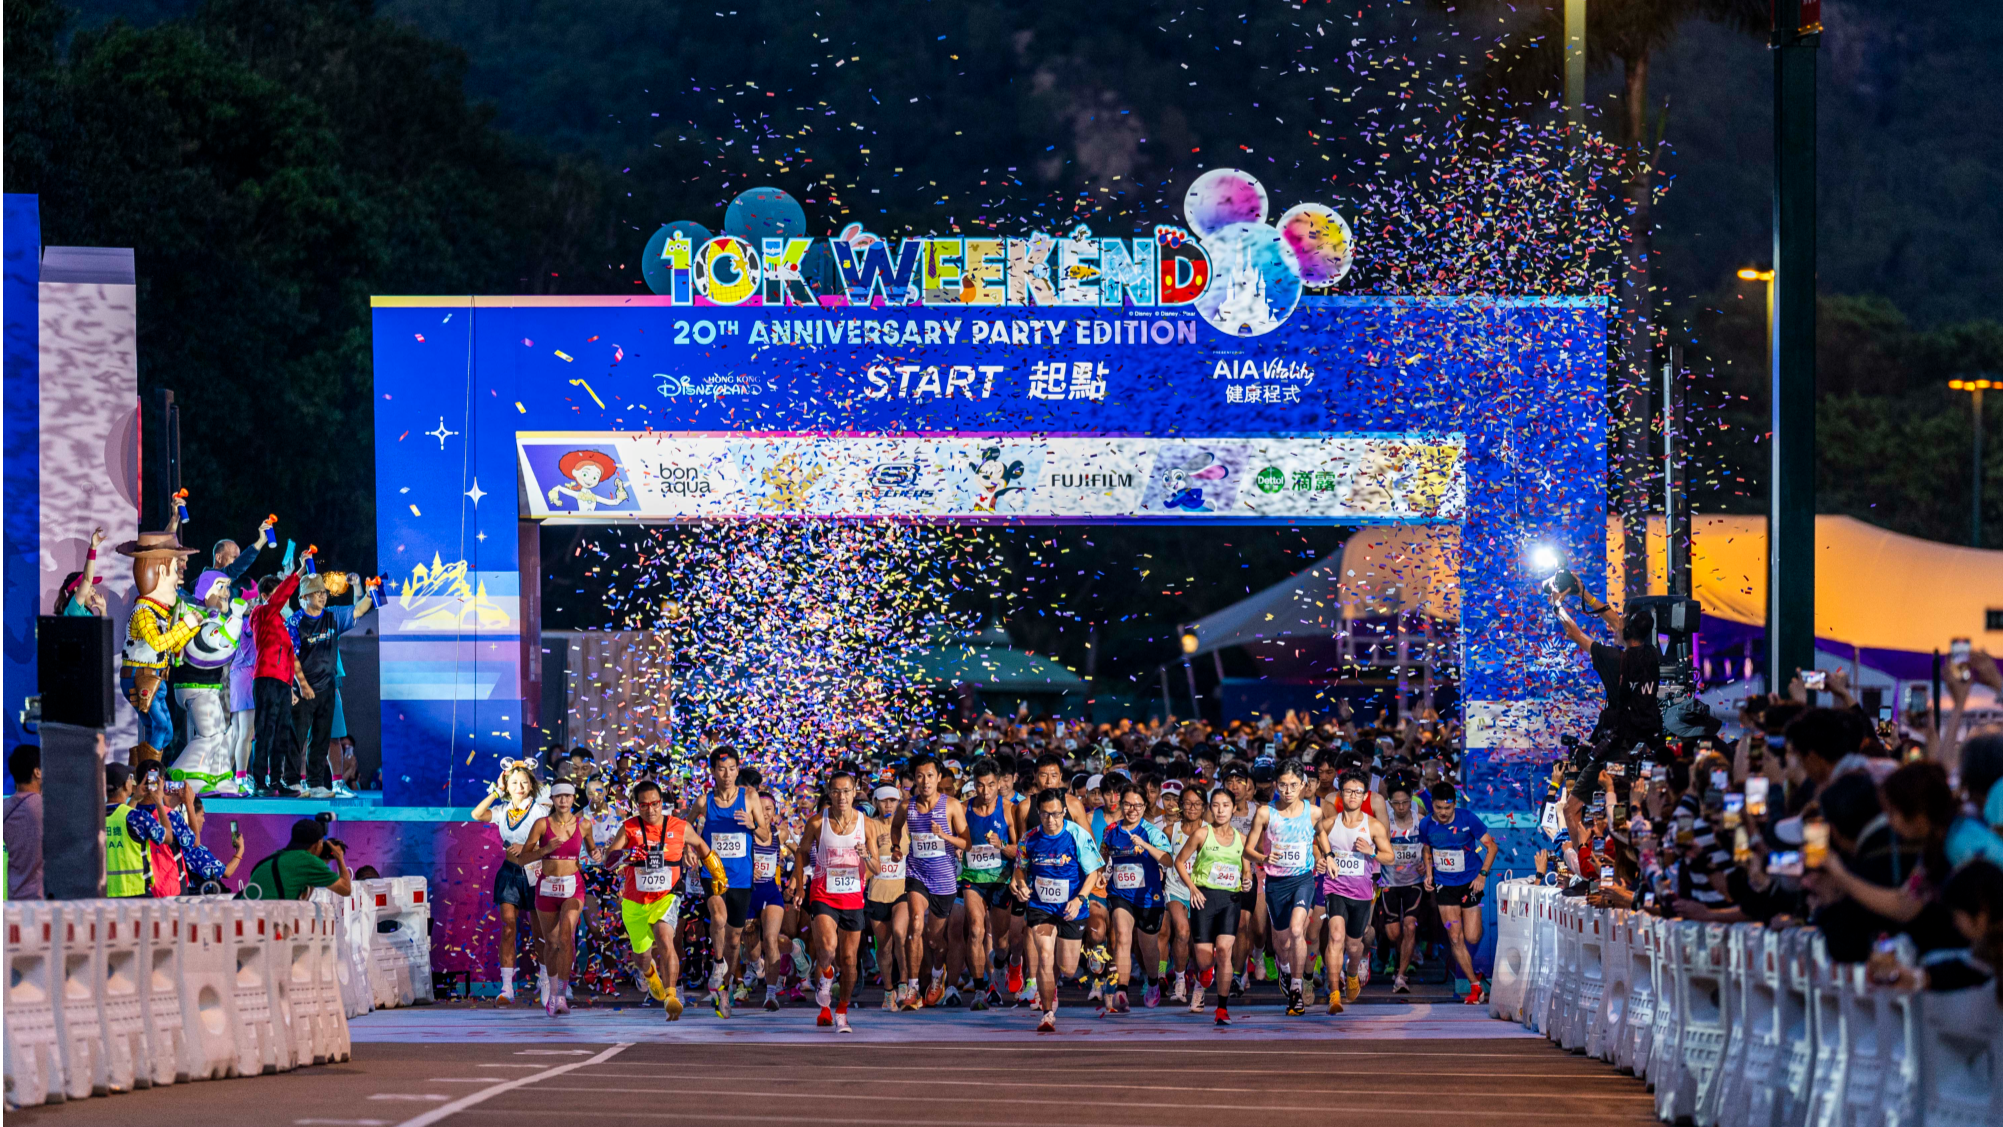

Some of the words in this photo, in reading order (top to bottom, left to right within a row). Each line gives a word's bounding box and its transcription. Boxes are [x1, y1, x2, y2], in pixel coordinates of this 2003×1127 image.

[660, 235, 822, 306] 10K
[828, 236, 1213, 307] WEEKEND
[673, 320, 739, 345] 20TH
[748, 320, 962, 345] ANNIVERSARY
[972, 320, 1066, 345] PARTY
[1076, 320, 1197, 345] EDITION
[1212, 359, 1260, 379] AIA
[1263, 356, 1316, 386] Vitality
[708, 375, 734, 383] HONG
[737, 375, 761, 383] KONG
[864, 365, 1004, 398] START
[1027, 360, 1110, 401] 起點
[1225, 384, 1301, 404] 健康程式
[659, 462, 698, 480] bon
[1051, 473, 1132, 488] FUJIFILM
[1257, 476, 1284, 485] Dettol
[1291, 471, 1336, 492] 滴露
[660, 480, 712, 497] aqua
[716, 841, 741, 851] 3239
[916, 841, 938, 851] 5178
[970, 852, 996, 863] 7054
[1396, 851, 1417, 860] 3184
[753, 861, 770, 871] 651
[881, 864, 899, 873] 607
[641, 875, 666, 885] 7079
[834, 876, 856, 887] 5137
[1117, 872, 1136, 882] 656
[1216, 872, 1235, 882] 245
[552, 883, 565, 893] 511
[1040, 886, 1062, 897] 7106
